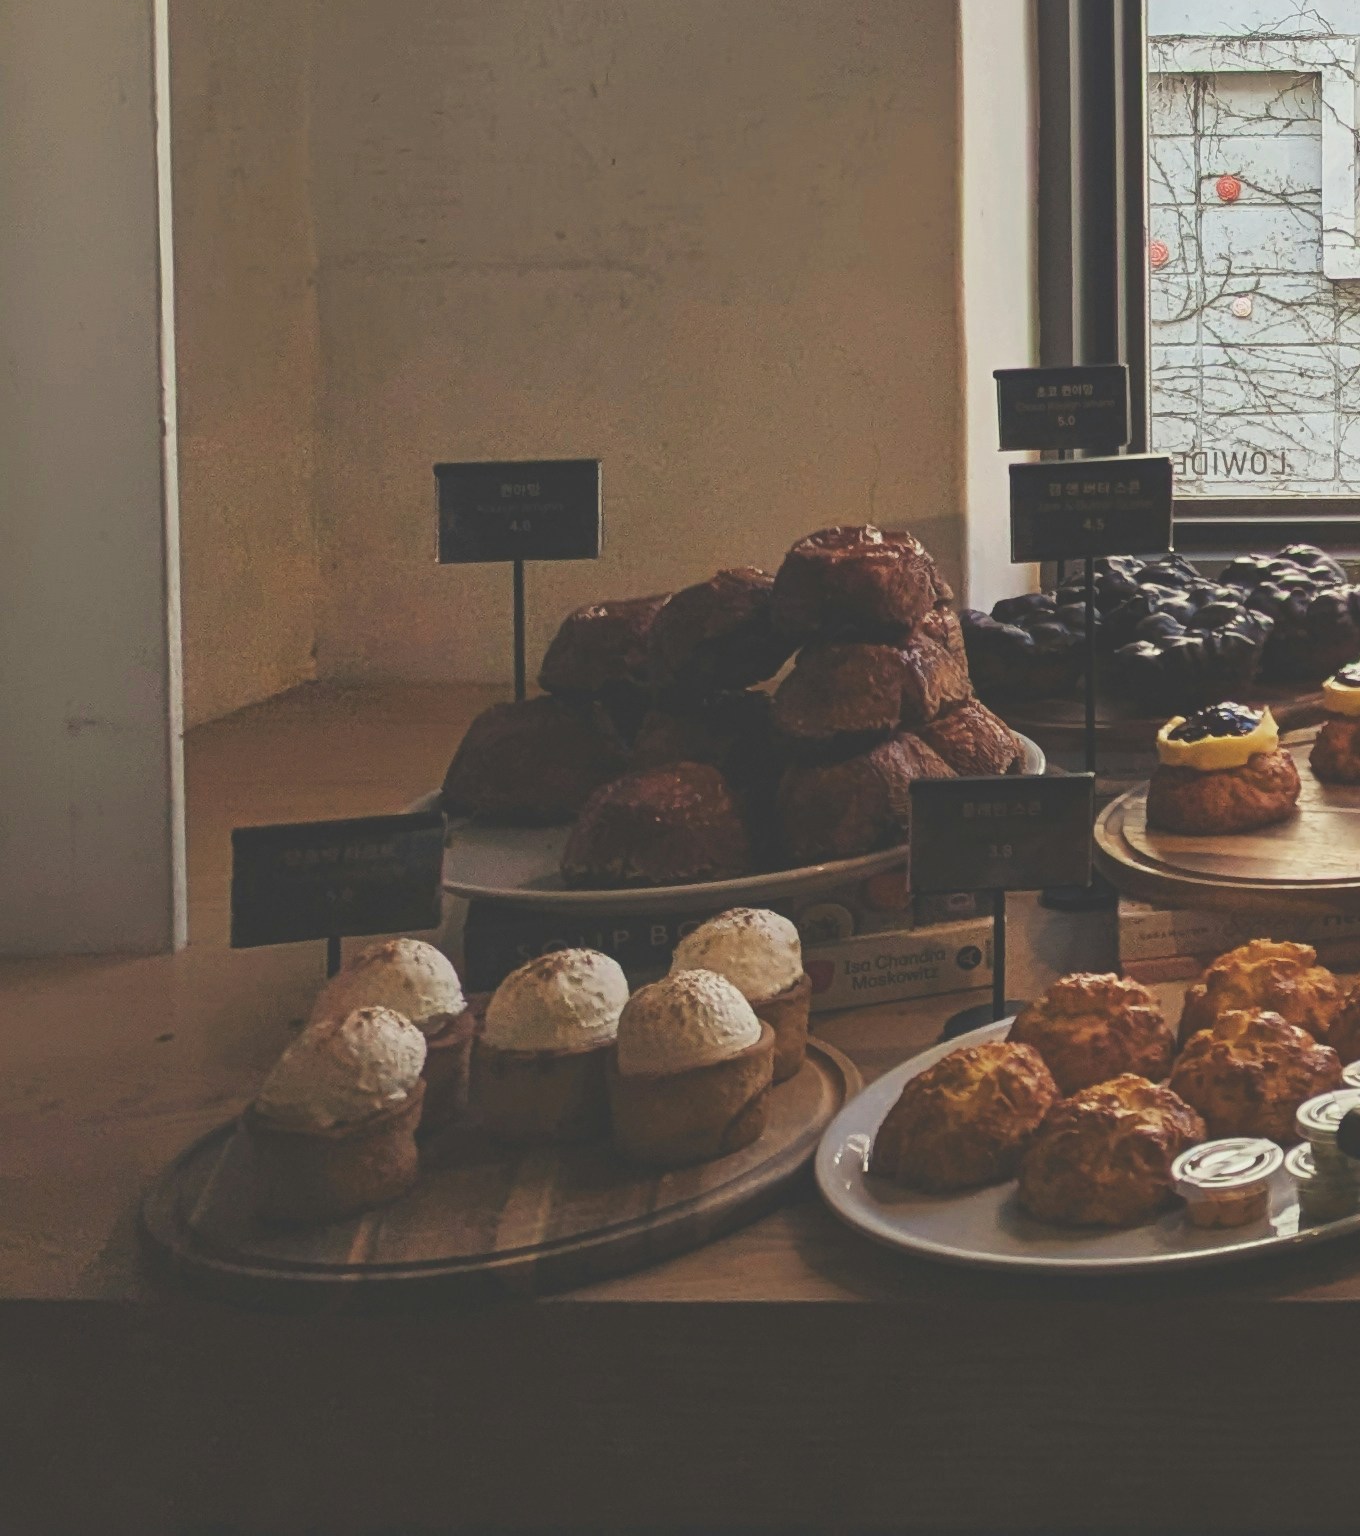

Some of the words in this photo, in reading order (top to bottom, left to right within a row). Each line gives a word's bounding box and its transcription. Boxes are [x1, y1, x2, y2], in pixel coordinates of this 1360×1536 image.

[1057, 415, 1076, 427] 5.0
[844, 959, 871, 975] Isa
[876, 948, 946, 969] Chandra
[853, 966, 939, 990] Moskowitz
